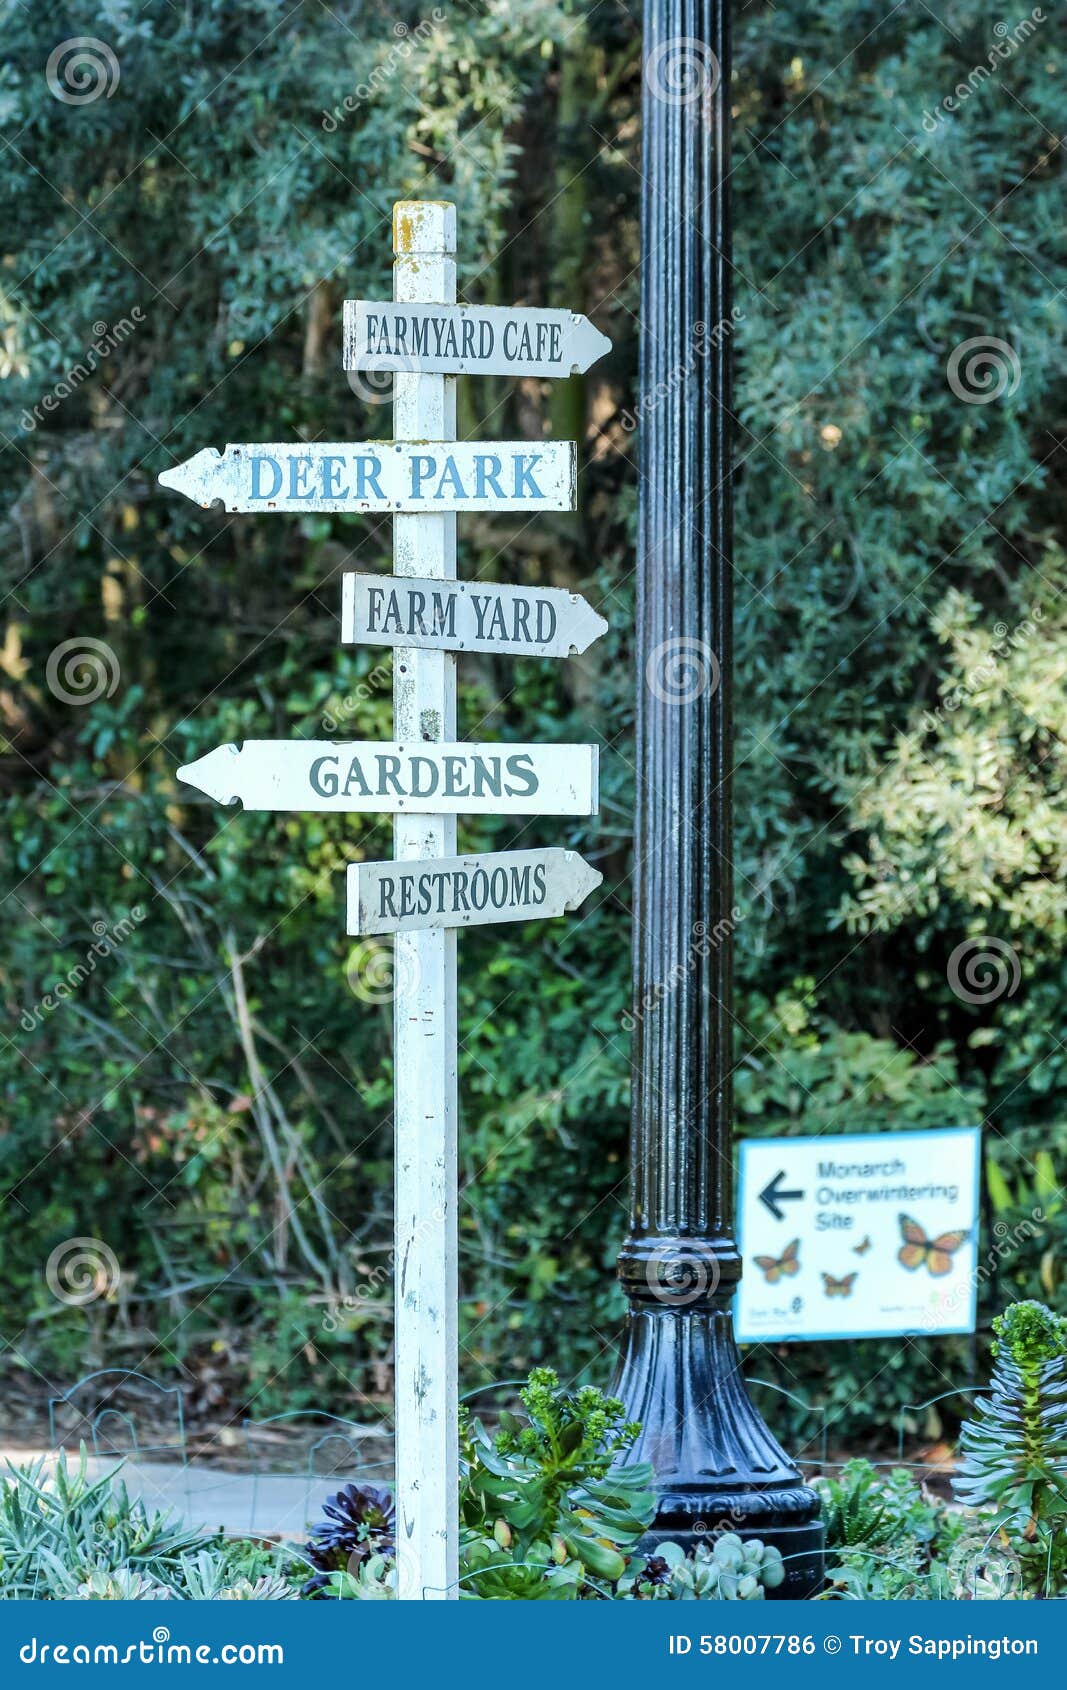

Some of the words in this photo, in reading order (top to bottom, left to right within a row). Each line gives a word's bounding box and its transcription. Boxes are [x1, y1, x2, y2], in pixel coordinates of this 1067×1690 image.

[365, 314, 495, 361] FARMYARD
[502, 322, 563, 363] CAFE
[248, 457, 388, 500] DEER
[408, 454, 546, 500] PARK
[366, 587, 458, 638] FARM
[470, 594, 558, 643] YARD
[309, 754, 539, 798] GARDENS
[378, 864, 547, 918] RESTROOMS
[816, 1159, 906, 1179] Monarch
[815, 1183, 960, 1205] Overwintering
[816, 1211, 855, 1231] Site
